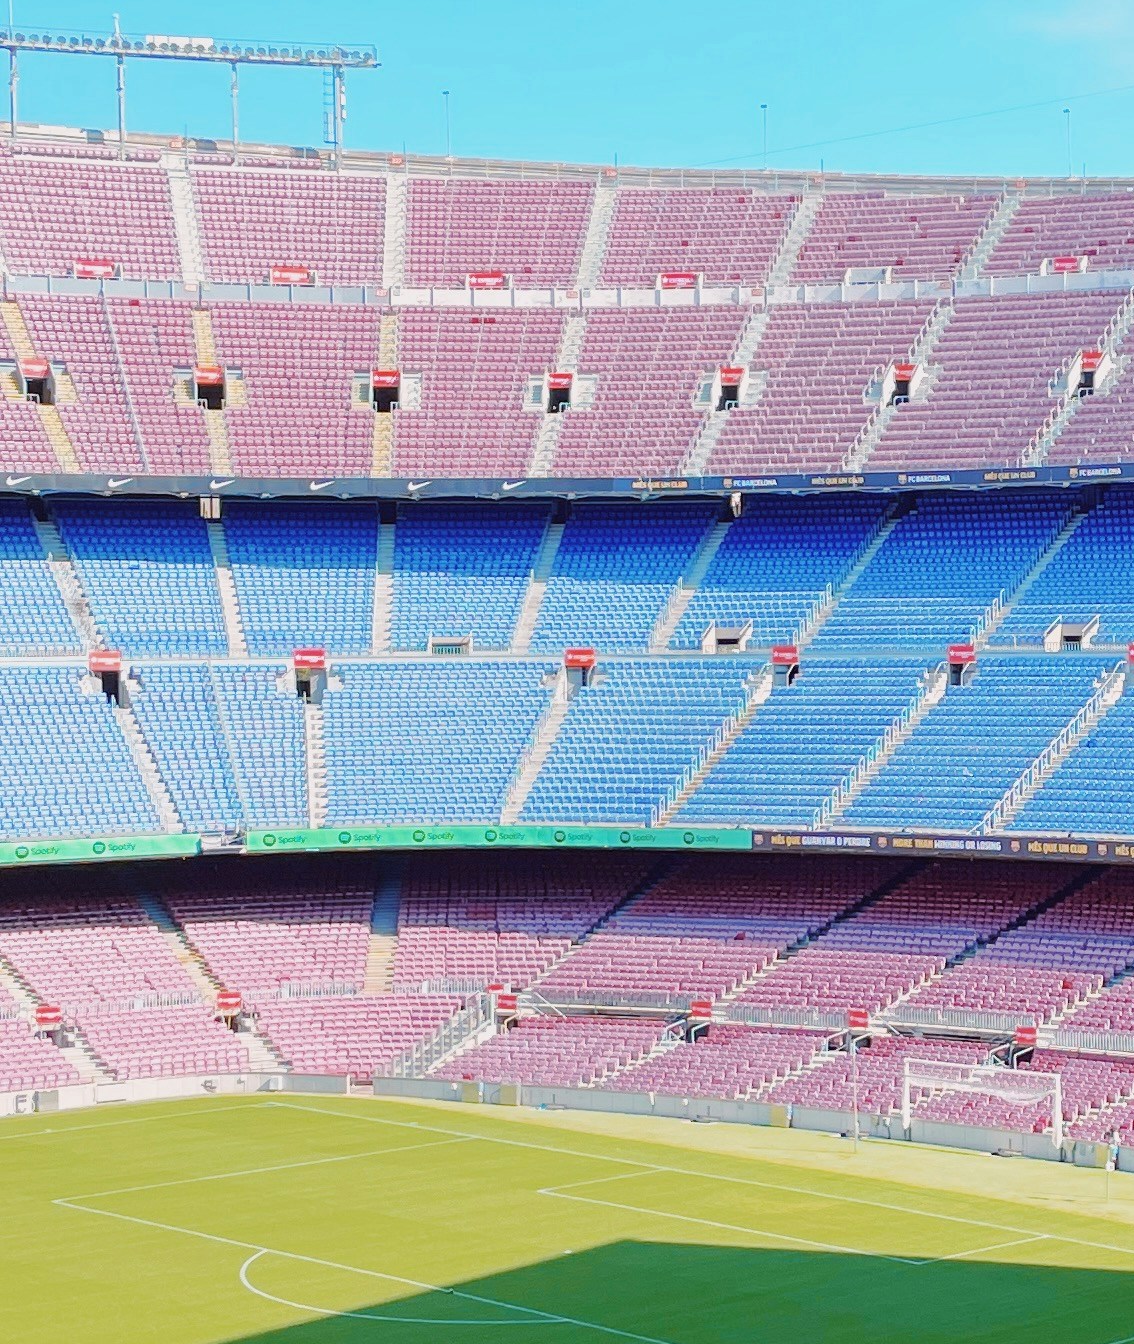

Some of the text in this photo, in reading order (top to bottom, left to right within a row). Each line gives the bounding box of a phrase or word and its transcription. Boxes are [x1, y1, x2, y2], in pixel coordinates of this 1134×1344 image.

[1079, 467, 1121, 476] FC BARCELONA
[733, 478, 777, 487] FC BARCELONA
[917, 475, 951, 483] BARCELONA
[278, 836, 306, 844] Spotify
[354, 833, 381, 842] Spotify
[428, 832, 454, 840] Spotify
[499, 832, 525, 841] Spotify
[568, 832, 592, 841] Spotify
[633, 833, 656, 843] Spotify
[696, 834, 720, 843] Spotify
[786, 836, 801, 847] QUE
[892, 838, 913, 848] MORE
[914, 838, 933, 849] THAN
[965, 840, 975, 850] OR
[976, 840, 1001, 851] LOSING
[31, 846, 60, 855] Spotify
[108, 842, 136, 852] Spotify
[1028, 840, 1088, 854] MÉS QUE UN CLUB
[1115, 844, 1129, 856] MÉS
